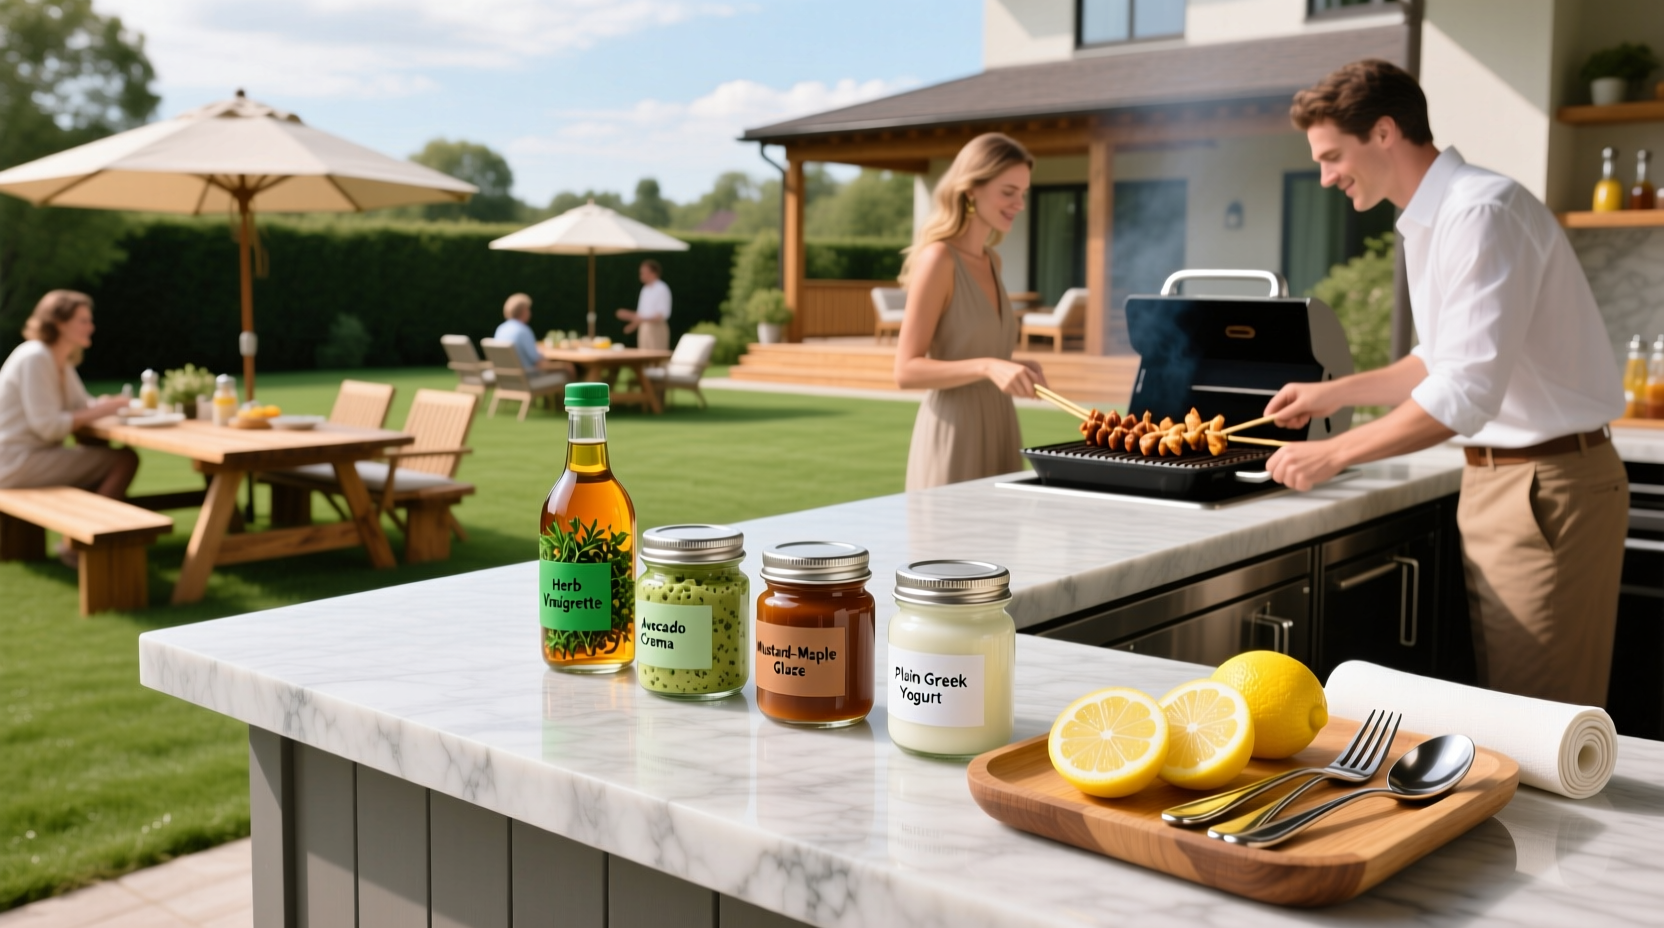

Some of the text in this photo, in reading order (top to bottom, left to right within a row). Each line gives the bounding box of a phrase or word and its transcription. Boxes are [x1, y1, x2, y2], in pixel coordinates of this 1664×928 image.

[552, 577, 582, 592] Herb
[895, 666, 968, 688] Plain Greek
[899, 684, 943, 706] Yogurt
